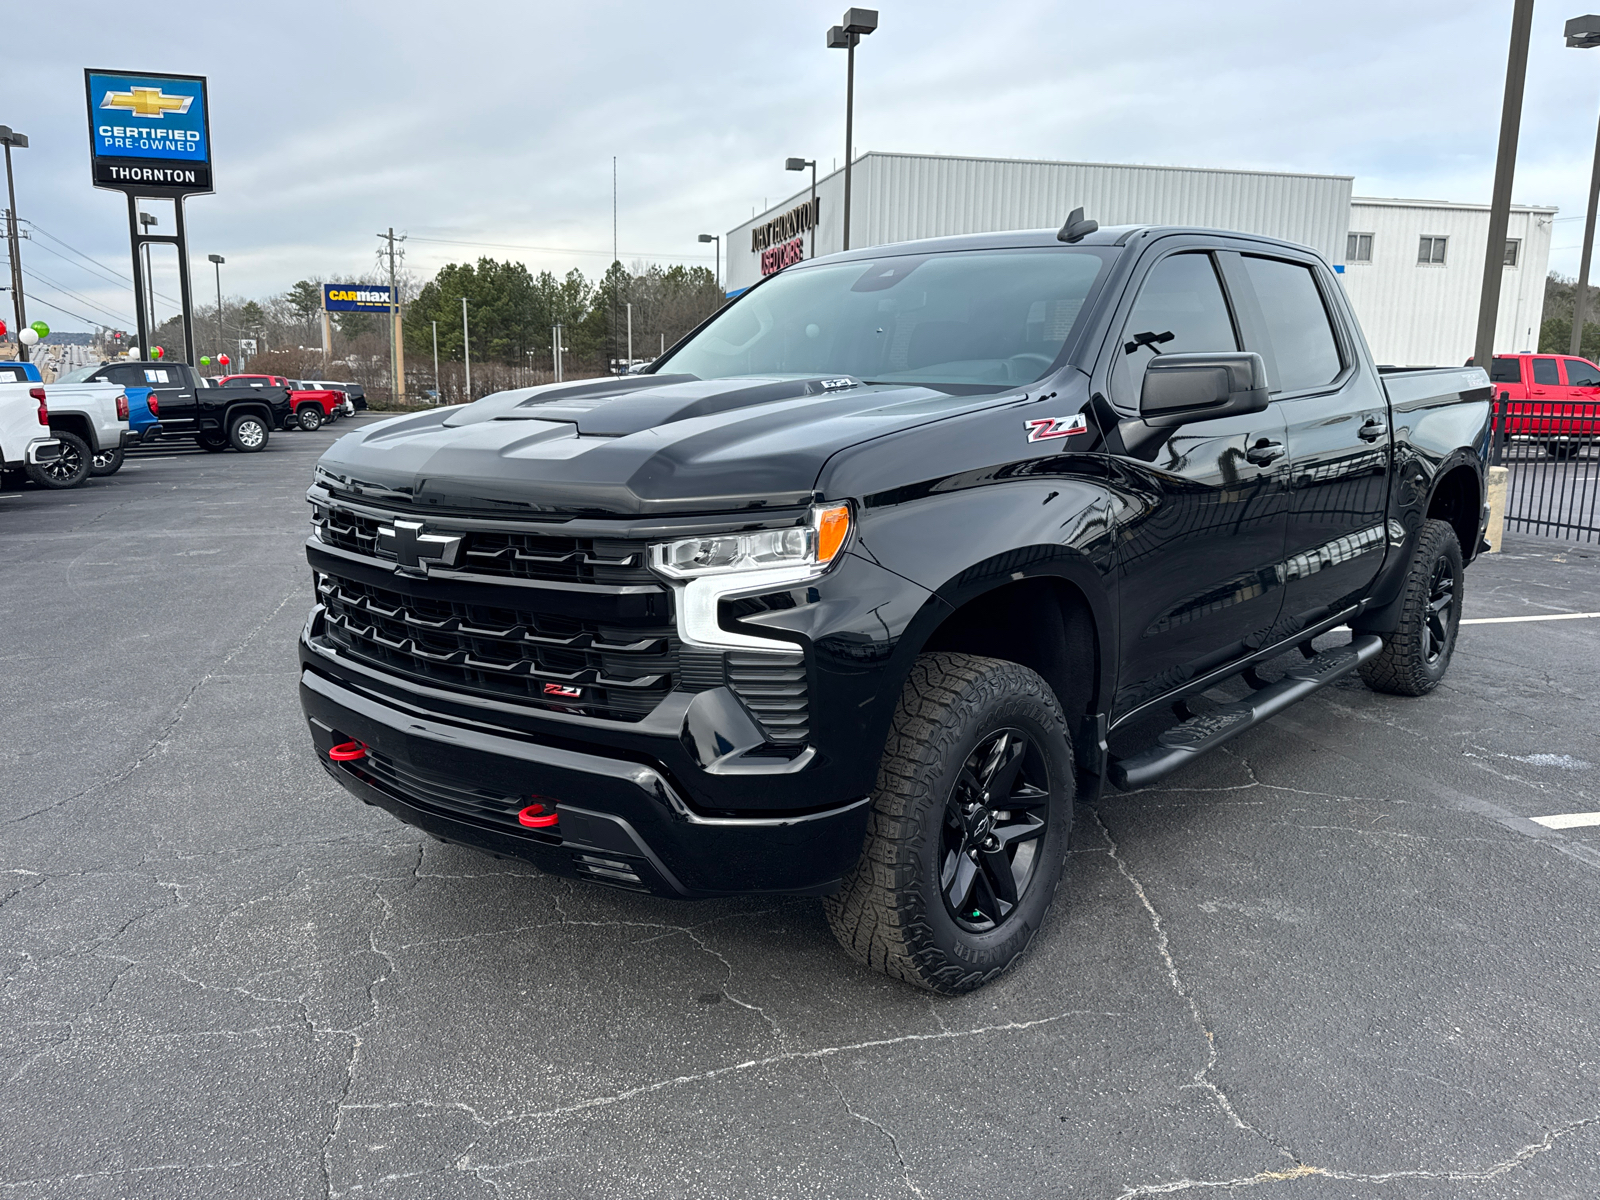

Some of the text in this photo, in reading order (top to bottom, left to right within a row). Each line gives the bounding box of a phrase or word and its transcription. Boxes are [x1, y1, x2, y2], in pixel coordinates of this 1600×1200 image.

[99, 126, 200, 141] CERTIFIED
[105, 138, 196, 152] PRE-OWNED
[110, 167, 195, 182] THORNTON
[761, 237, 804, 276] USED CARS
[1024, 413, 1088, 444] Z71
[543, 683, 583, 698] Z71
[975, 699, 1055, 737] GOODYEAR
